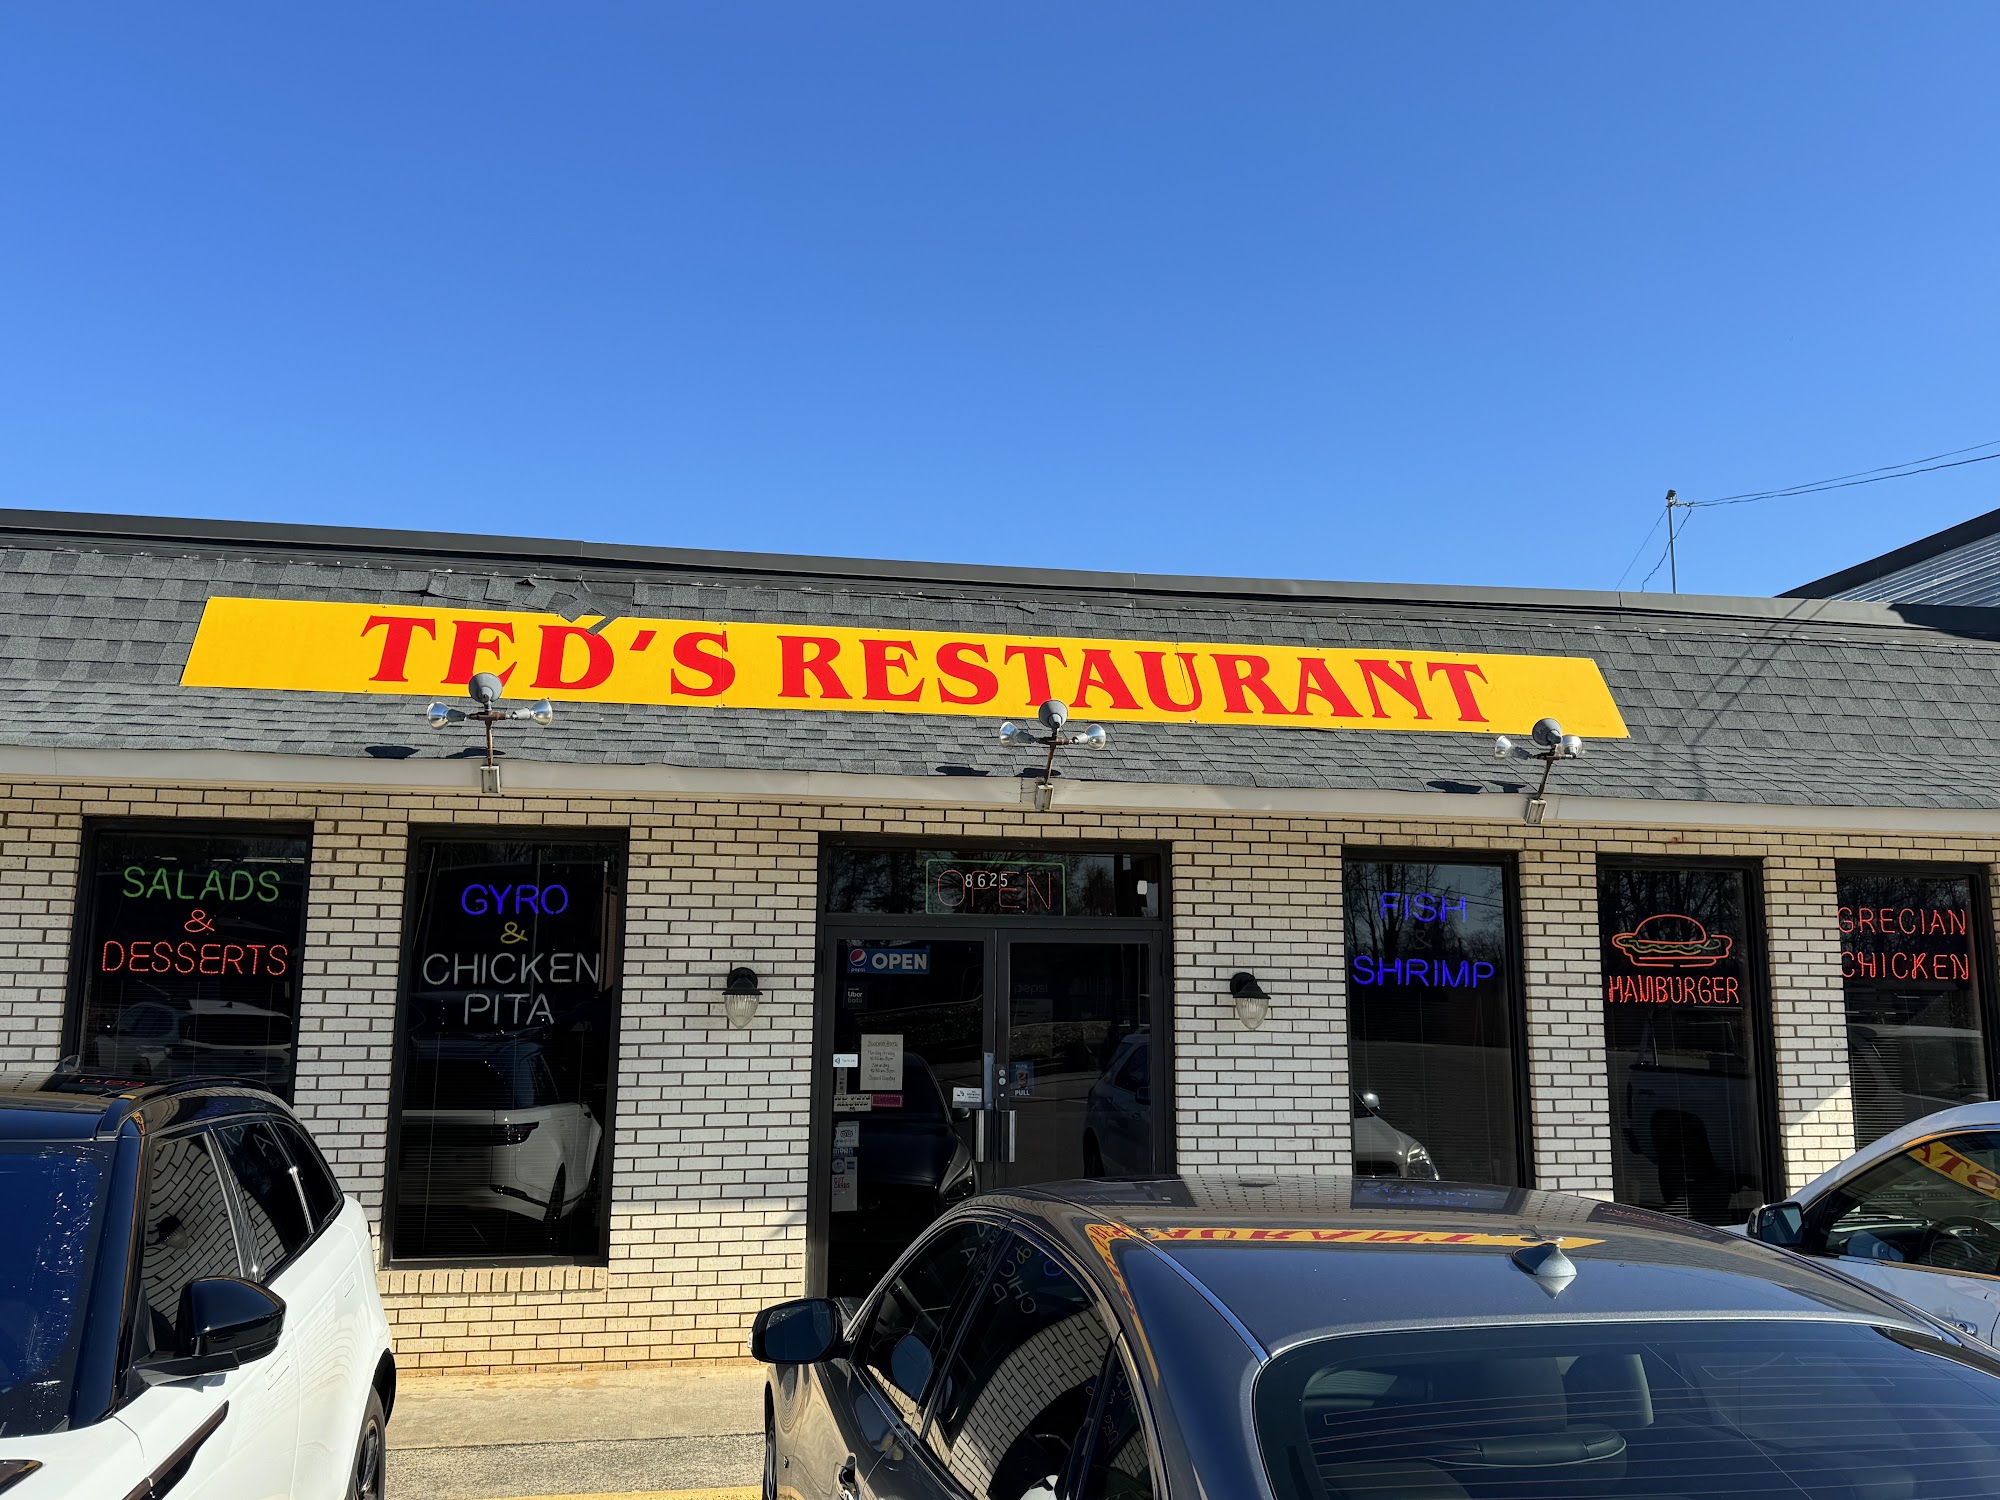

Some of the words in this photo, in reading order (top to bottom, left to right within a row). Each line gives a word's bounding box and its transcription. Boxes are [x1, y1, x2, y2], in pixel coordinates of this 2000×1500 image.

[360, 615, 736, 697] TED'S
[776, 635, 1490, 723] RESTAURANT
[122, 866, 281, 903] SALADS
[937, 869, 1052, 910] OPEN
[965, 872, 1008, 888] 8625
[460, 883, 570, 916] GYRO
[1379, 892, 1467, 923] FISH
[184, 908, 215, 933] &
[499, 920, 528, 943] &
[1837, 907, 1967, 935] GRECIAN
[102, 940, 289, 976] DESSERTS
[422, 952, 600, 985] CHICKEN
[871, 952, 927, 970] OPEN
[1352, 955, 1495, 988] SHRIMP
[1841, 951, 1969, 980] CHICKEN
[1014, 982, 1049, 995] pepsi
[1608, 974, 1740, 1004] HAMBURGER
[463, 993, 555, 1025] PITA
